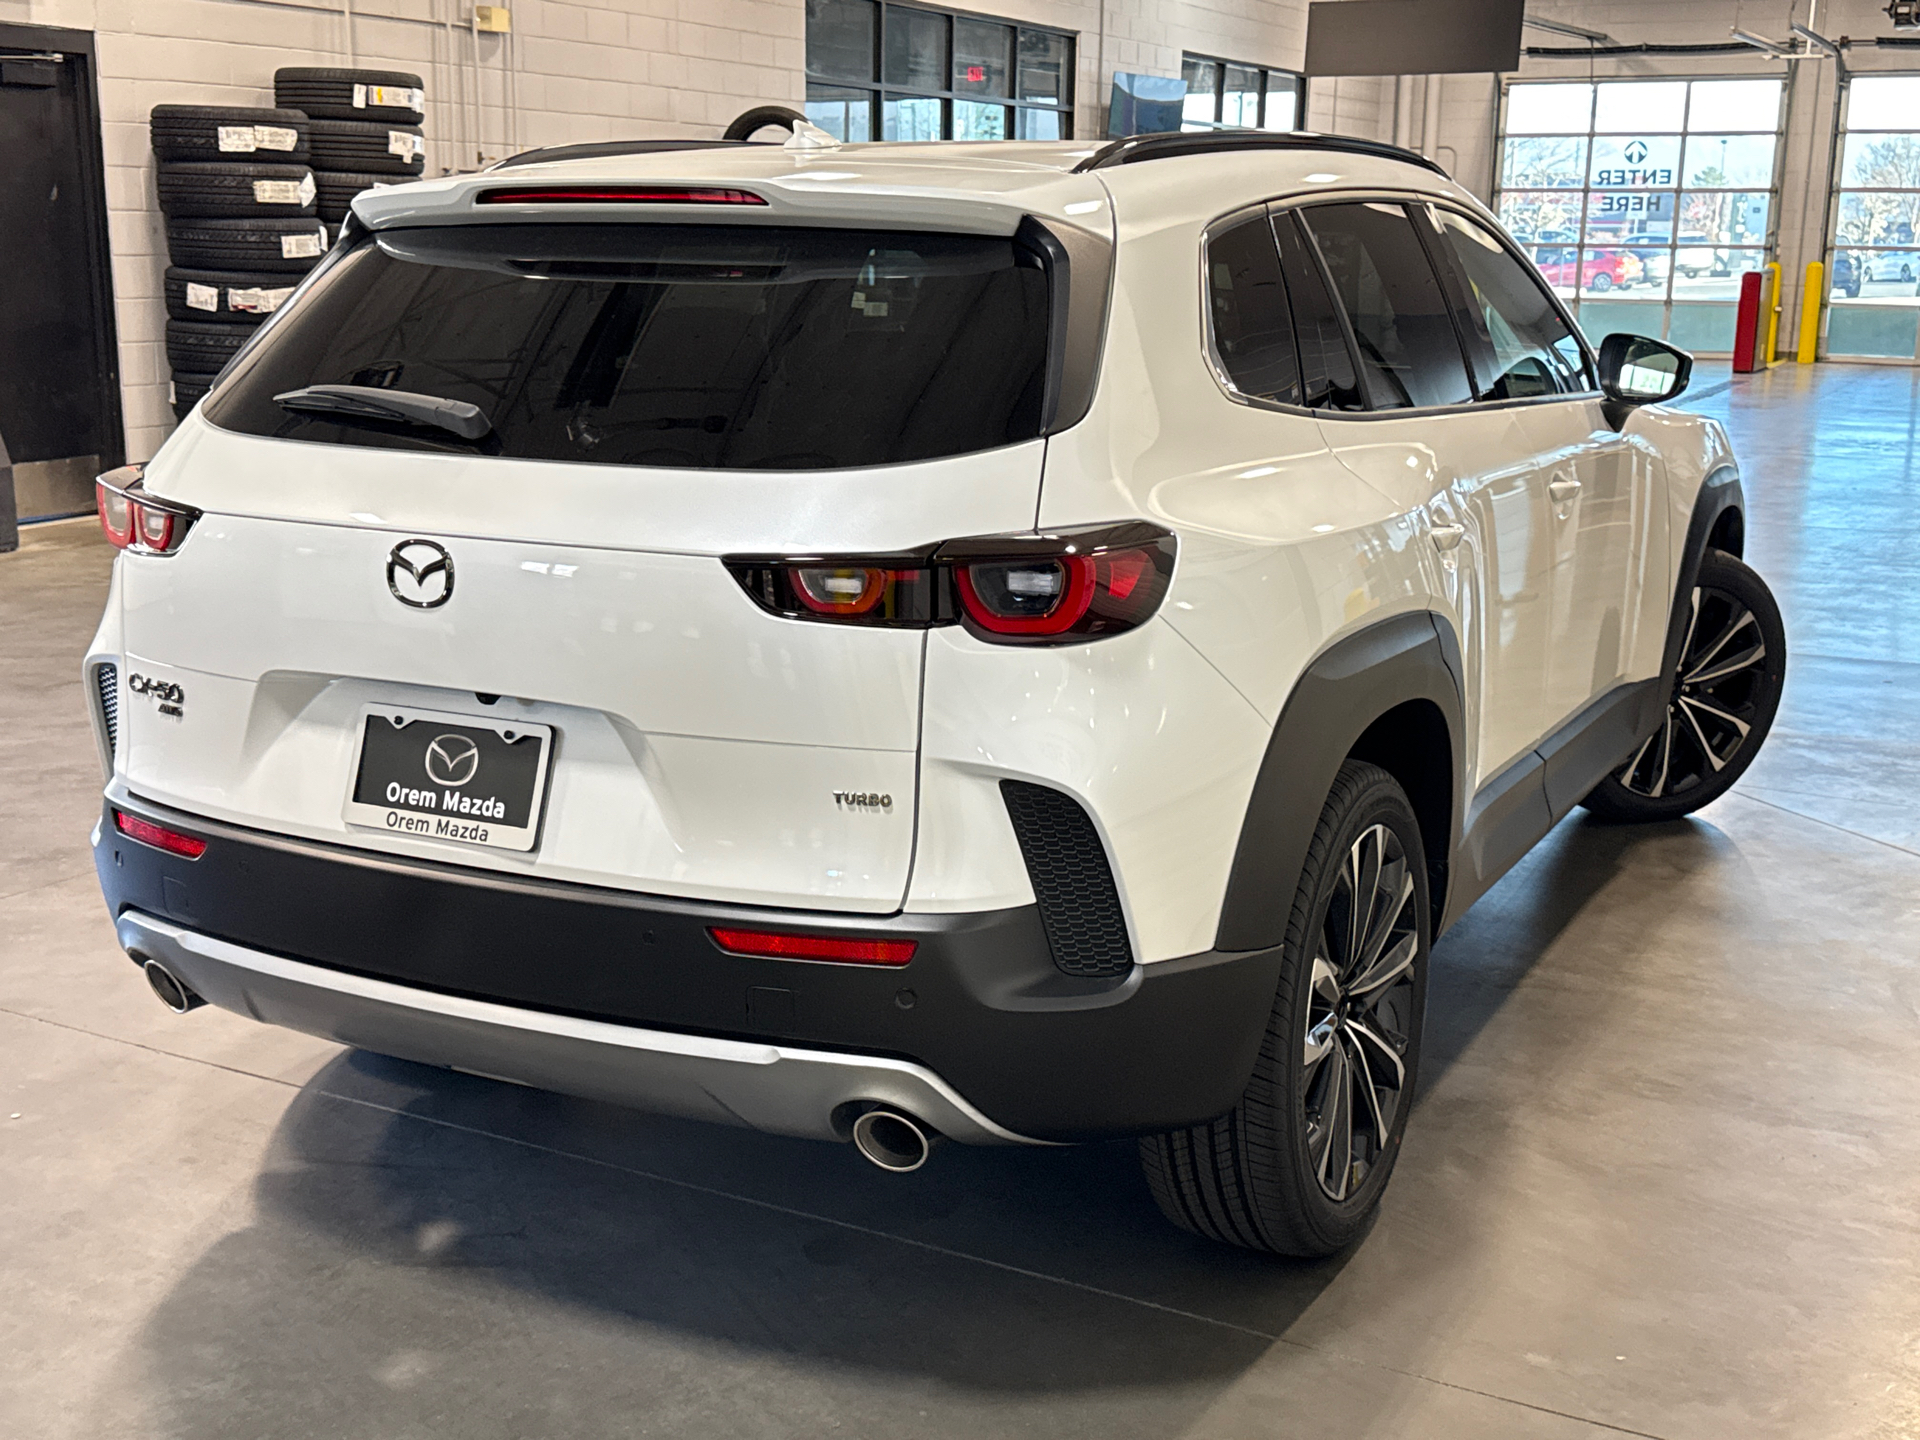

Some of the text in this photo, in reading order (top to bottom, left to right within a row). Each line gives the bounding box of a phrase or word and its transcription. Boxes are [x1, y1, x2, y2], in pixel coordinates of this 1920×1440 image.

[386, 782, 505, 819] Orem Mazda
[832, 790, 892, 807] TURBO
[386, 811, 489, 842] Orem Mazda
